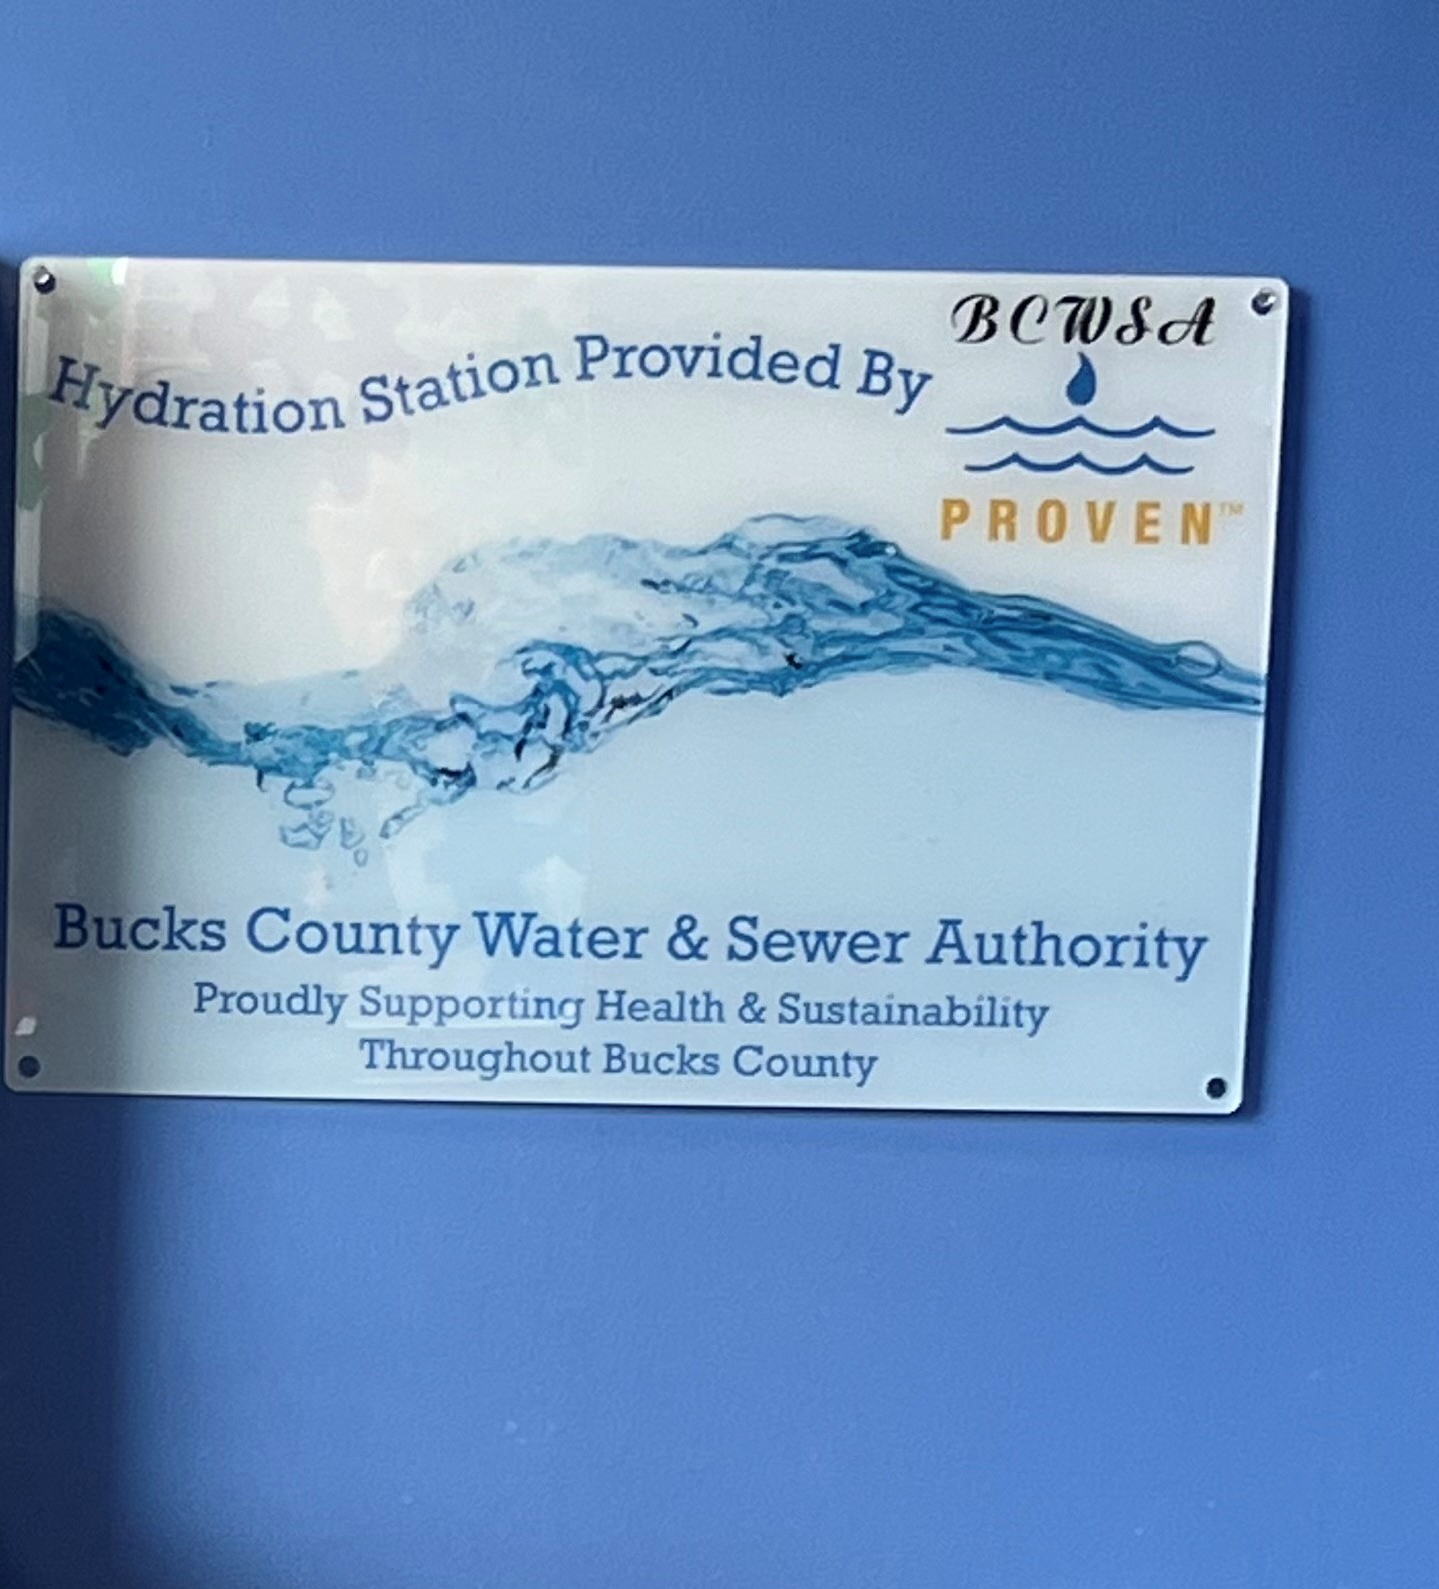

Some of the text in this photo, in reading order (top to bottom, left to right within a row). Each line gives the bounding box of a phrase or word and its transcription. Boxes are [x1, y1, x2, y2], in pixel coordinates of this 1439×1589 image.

[950, 293, 1217, 346] BCWSA
[48, 332, 934, 434] Hydration Station Provided By
[53, 903, 1209, 982] Bucks County Water & Sewer Authority
[194, 981, 1051, 1037] Proudly Supporting Health & Sustainability
[359, 1037, 879, 1087] Throughout Bucks County
